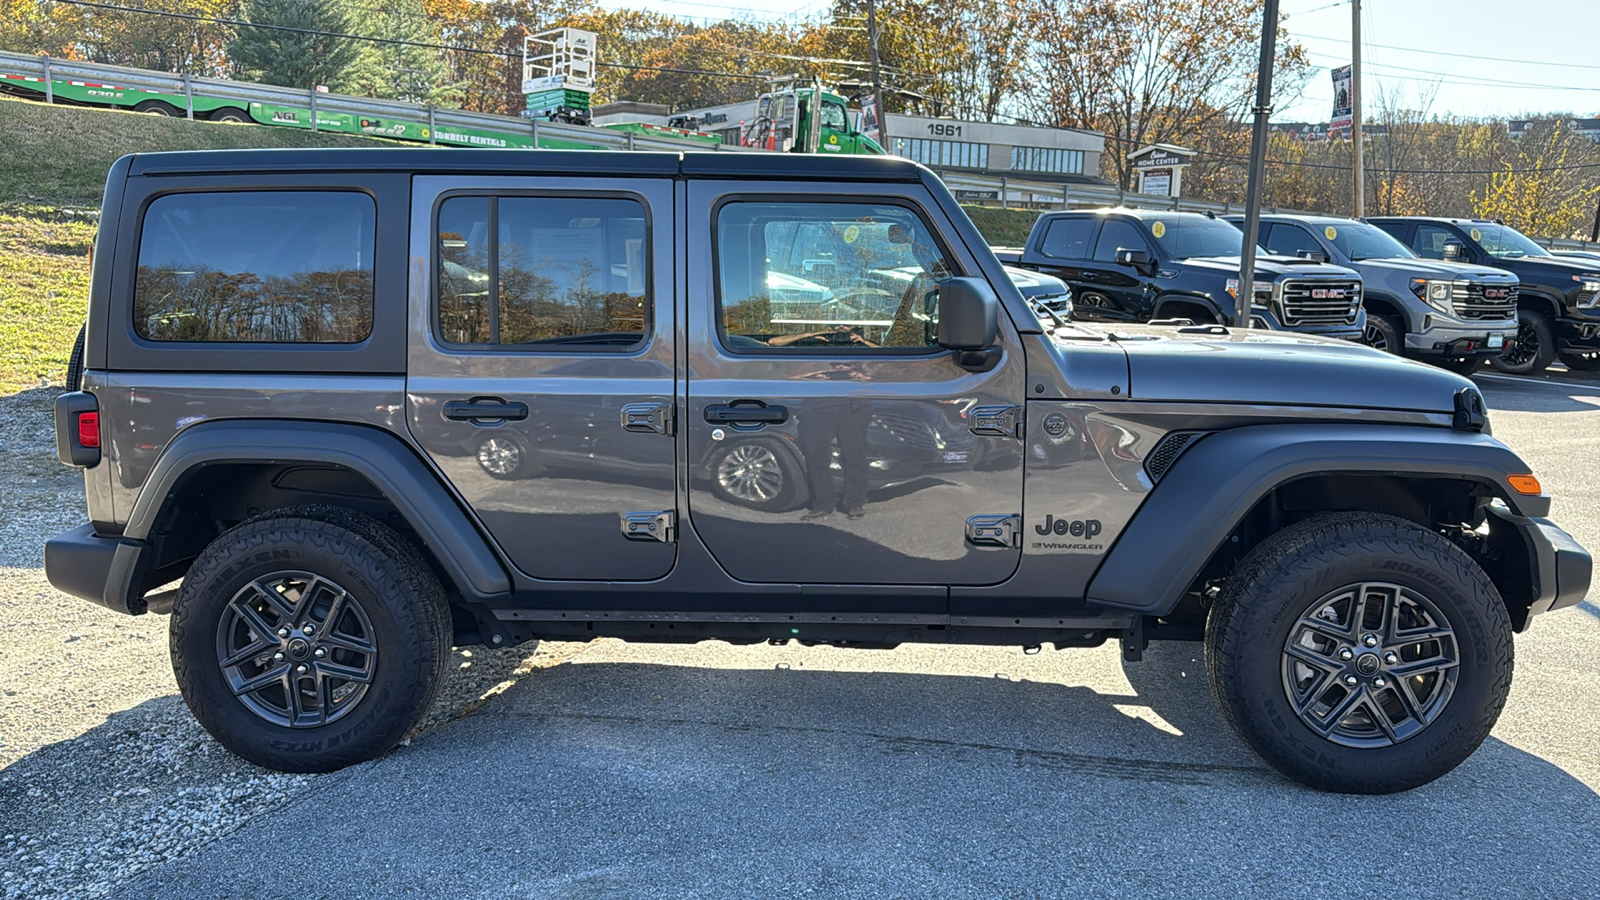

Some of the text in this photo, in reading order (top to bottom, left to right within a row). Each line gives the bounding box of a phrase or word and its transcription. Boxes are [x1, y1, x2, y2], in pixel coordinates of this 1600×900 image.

[927, 123, 962, 137] 1961
[470, 136, 506, 147] RENTALS
[1312, 289, 1344, 298] GMC
[1486, 289, 1509, 298] GMC
[1035, 514, 1102, 540] Jeep
[207, 549, 291, 595] NEXEN
[1264, 698, 1337, 770] NEXEN
